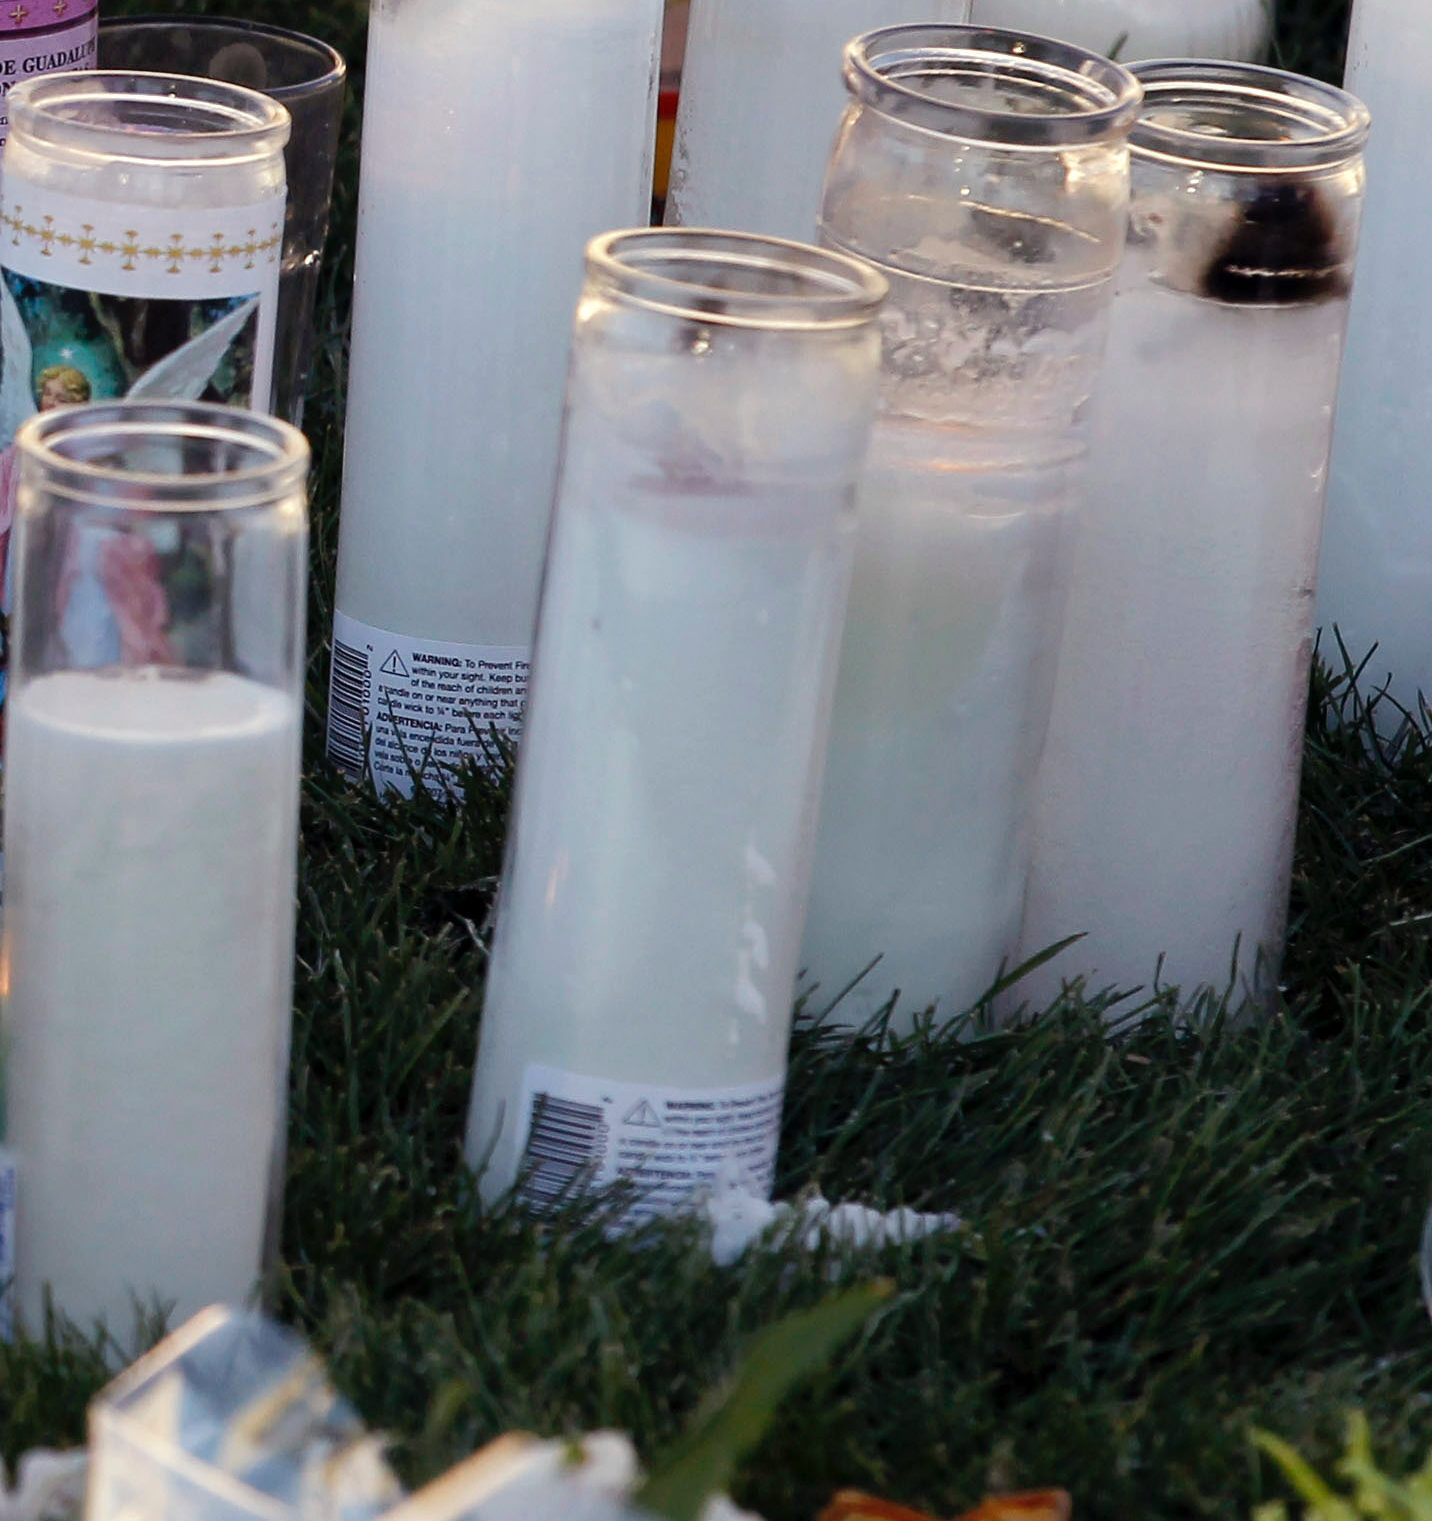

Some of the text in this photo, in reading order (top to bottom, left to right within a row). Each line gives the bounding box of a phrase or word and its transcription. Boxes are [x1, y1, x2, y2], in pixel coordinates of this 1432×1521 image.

[412, 652, 462, 668] WARNING:
[465, 659, 476, 669] To
[478, 660, 513, 670] Prevent
[412, 667, 528, 684] within your sight. Keep bu
[411, 679, 527, 695] of the reach of children an
[437, 695, 456, 704] near
[459, 698, 497, 709] anything
[500, 699, 517, 707] that
[405, 703, 423, 712] wick
[425, 705, 434, 714] to
[452, 709, 481, 718] beore
[484, 710, 506, 719] each
[509, 711, 522, 722] lig
[445, 723, 466, 734] Para
